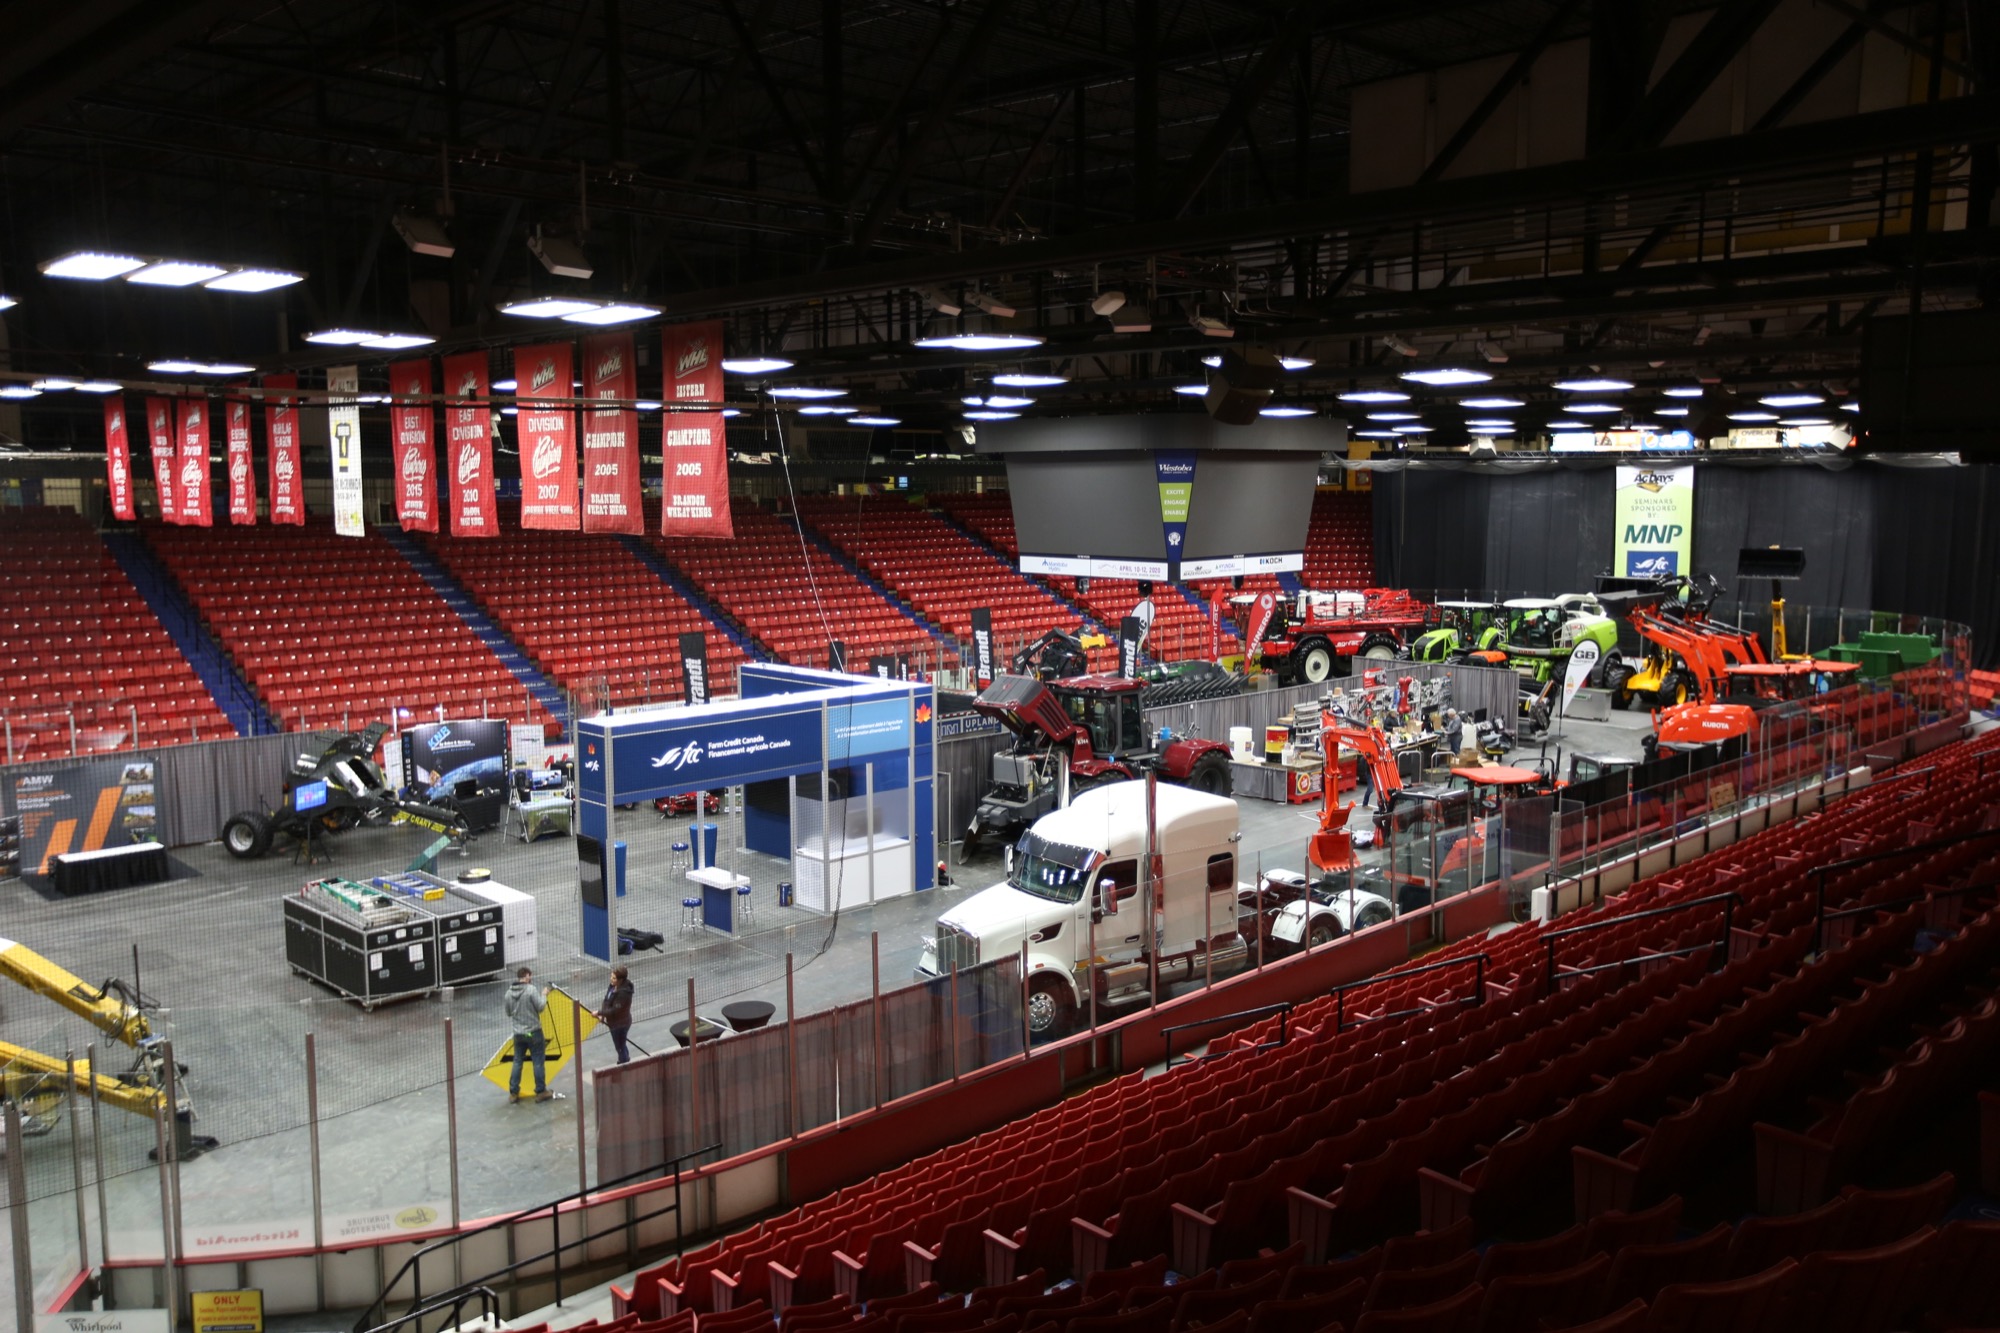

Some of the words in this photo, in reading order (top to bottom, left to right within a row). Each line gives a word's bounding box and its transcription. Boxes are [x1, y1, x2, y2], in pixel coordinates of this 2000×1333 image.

[679, 348, 707, 372] WHL
[599, 357, 621, 379] WHL
[533, 366, 555, 389] WHL
[528, 416, 564, 433] DIVISION
[452, 424, 483, 441] DIVISION
[667, 428, 711, 447] CHAMPIONS
[585, 432, 625, 449] CHAMPIONS
[594, 464, 618, 476] 2005
[676, 463, 702, 476] 2005
[1159, 464, 1193, 472] Westoba
[406, 484, 423, 497] 2015
[463, 489, 479, 502] 2010
[538, 485, 560, 499] 2007
[673, 494, 706, 506] BRANDON
[667, 506, 690, 518] WHEAT
[691, 506, 713, 518] KINGS
[1624, 524, 1683, 544] MNP
[1265, 557, 1283, 565] KOCH
[1247, 609, 1272, 660] MAINERO
[1029, 638, 1044, 651] DEERE
[975, 629, 991, 679] Brandt
[1123, 638, 1137, 681] randt
[1574, 650, 1596, 661] GB
[685, 657, 705, 705] randt
[1702, 720, 1729, 730] KUBOTA
[708, 741, 723, 750] Farm
[723, 738, 741, 747] Credit
[742, 735, 764, 745] Canada
[708, 746, 745, 759] Financement
[745, 743, 768, 754] agricole
[769, 739, 791, 749] Canada
[674, 741, 703, 771] fcc
[23, 774, 54, 786] AMW
[213, 1295, 240, 1305] ONLY
[70, 1321, 122, 1333] Whirlpool
